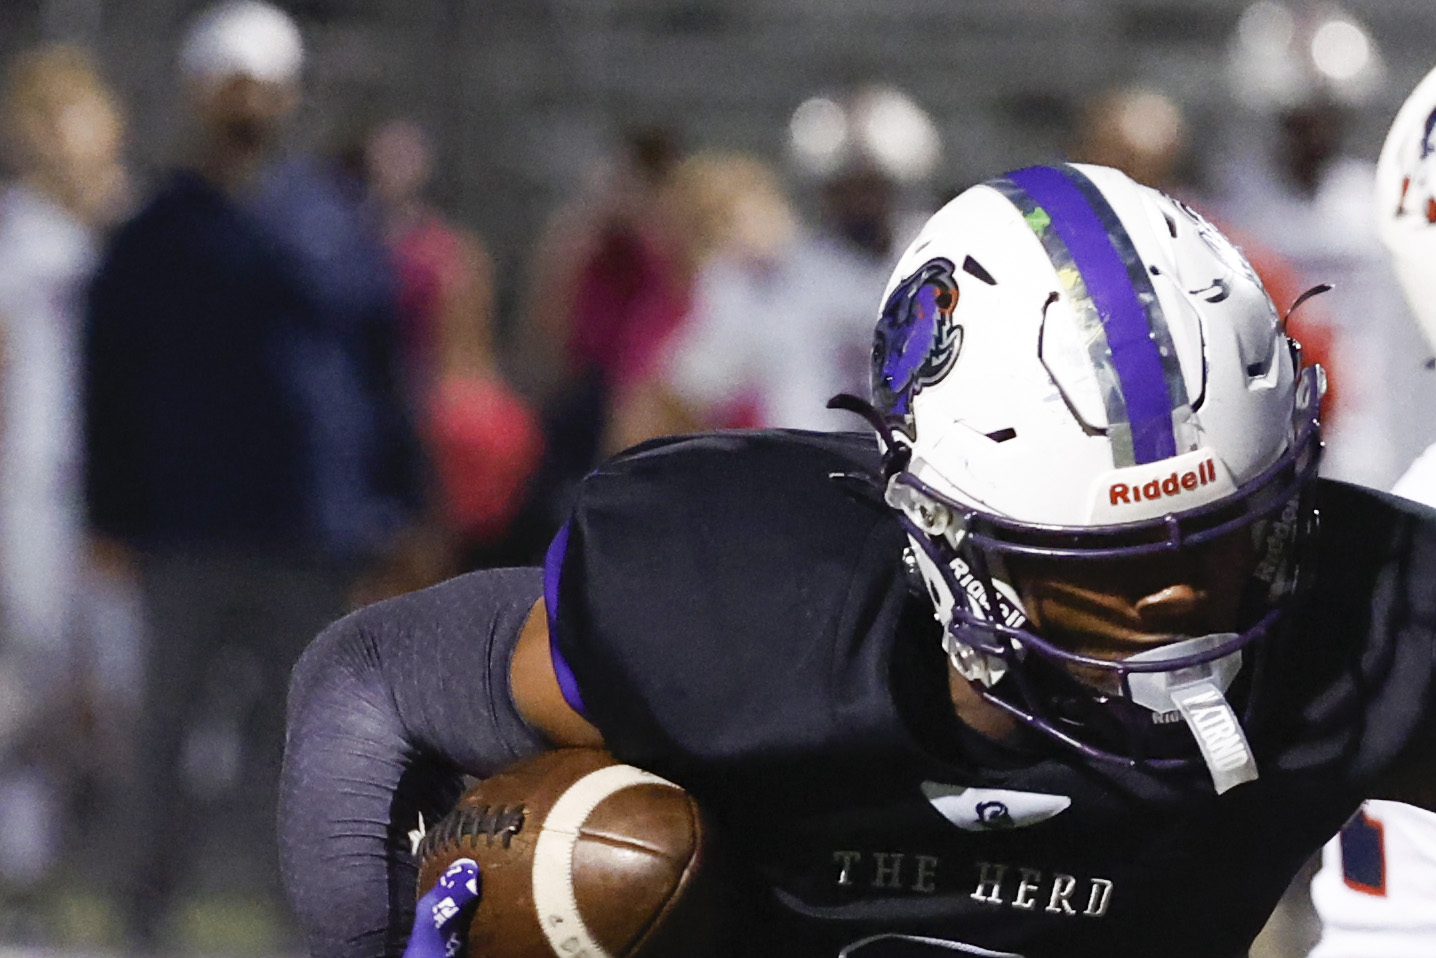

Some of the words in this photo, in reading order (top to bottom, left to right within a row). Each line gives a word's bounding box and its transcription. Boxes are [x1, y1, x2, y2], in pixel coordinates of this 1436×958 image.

[1109, 457, 1216, 506] Riddell
[833, 850, 939, 893] THE
[970, 860, 1114, 918] HERD
